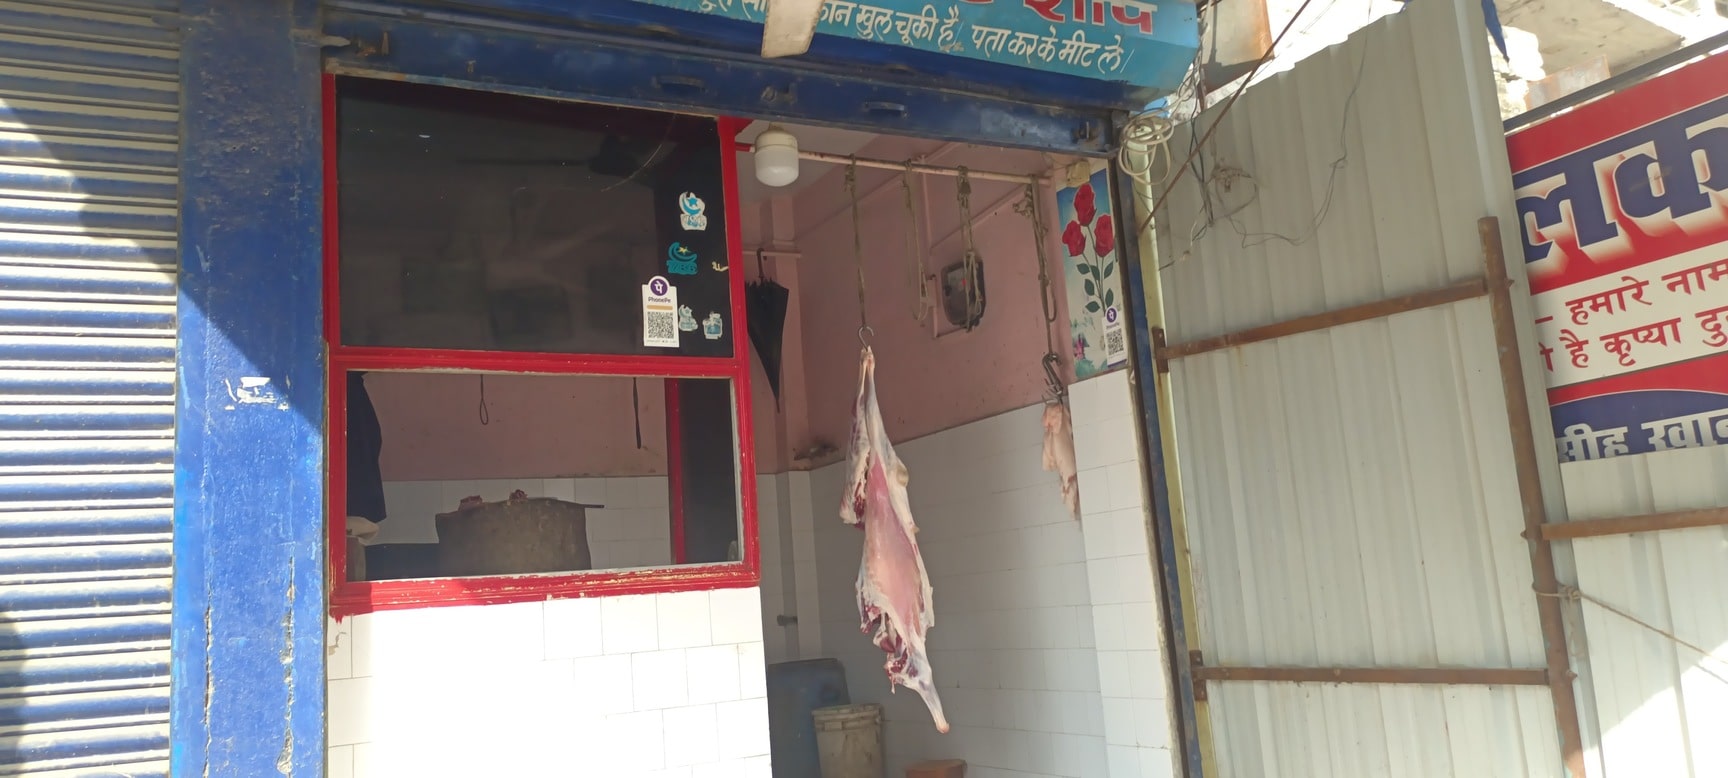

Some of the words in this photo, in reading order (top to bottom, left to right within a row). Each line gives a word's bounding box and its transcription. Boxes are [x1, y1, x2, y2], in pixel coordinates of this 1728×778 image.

[971, 24, 1011, 58] पता
[1058, 29, 1102, 67] मीट
[1565, 276, 1652, 326] हमारे
[1559, 329, 1589, 369] है
[1599, 317, 1682, 367] कृप्या
[1695, 306, 1728, 348] दु
